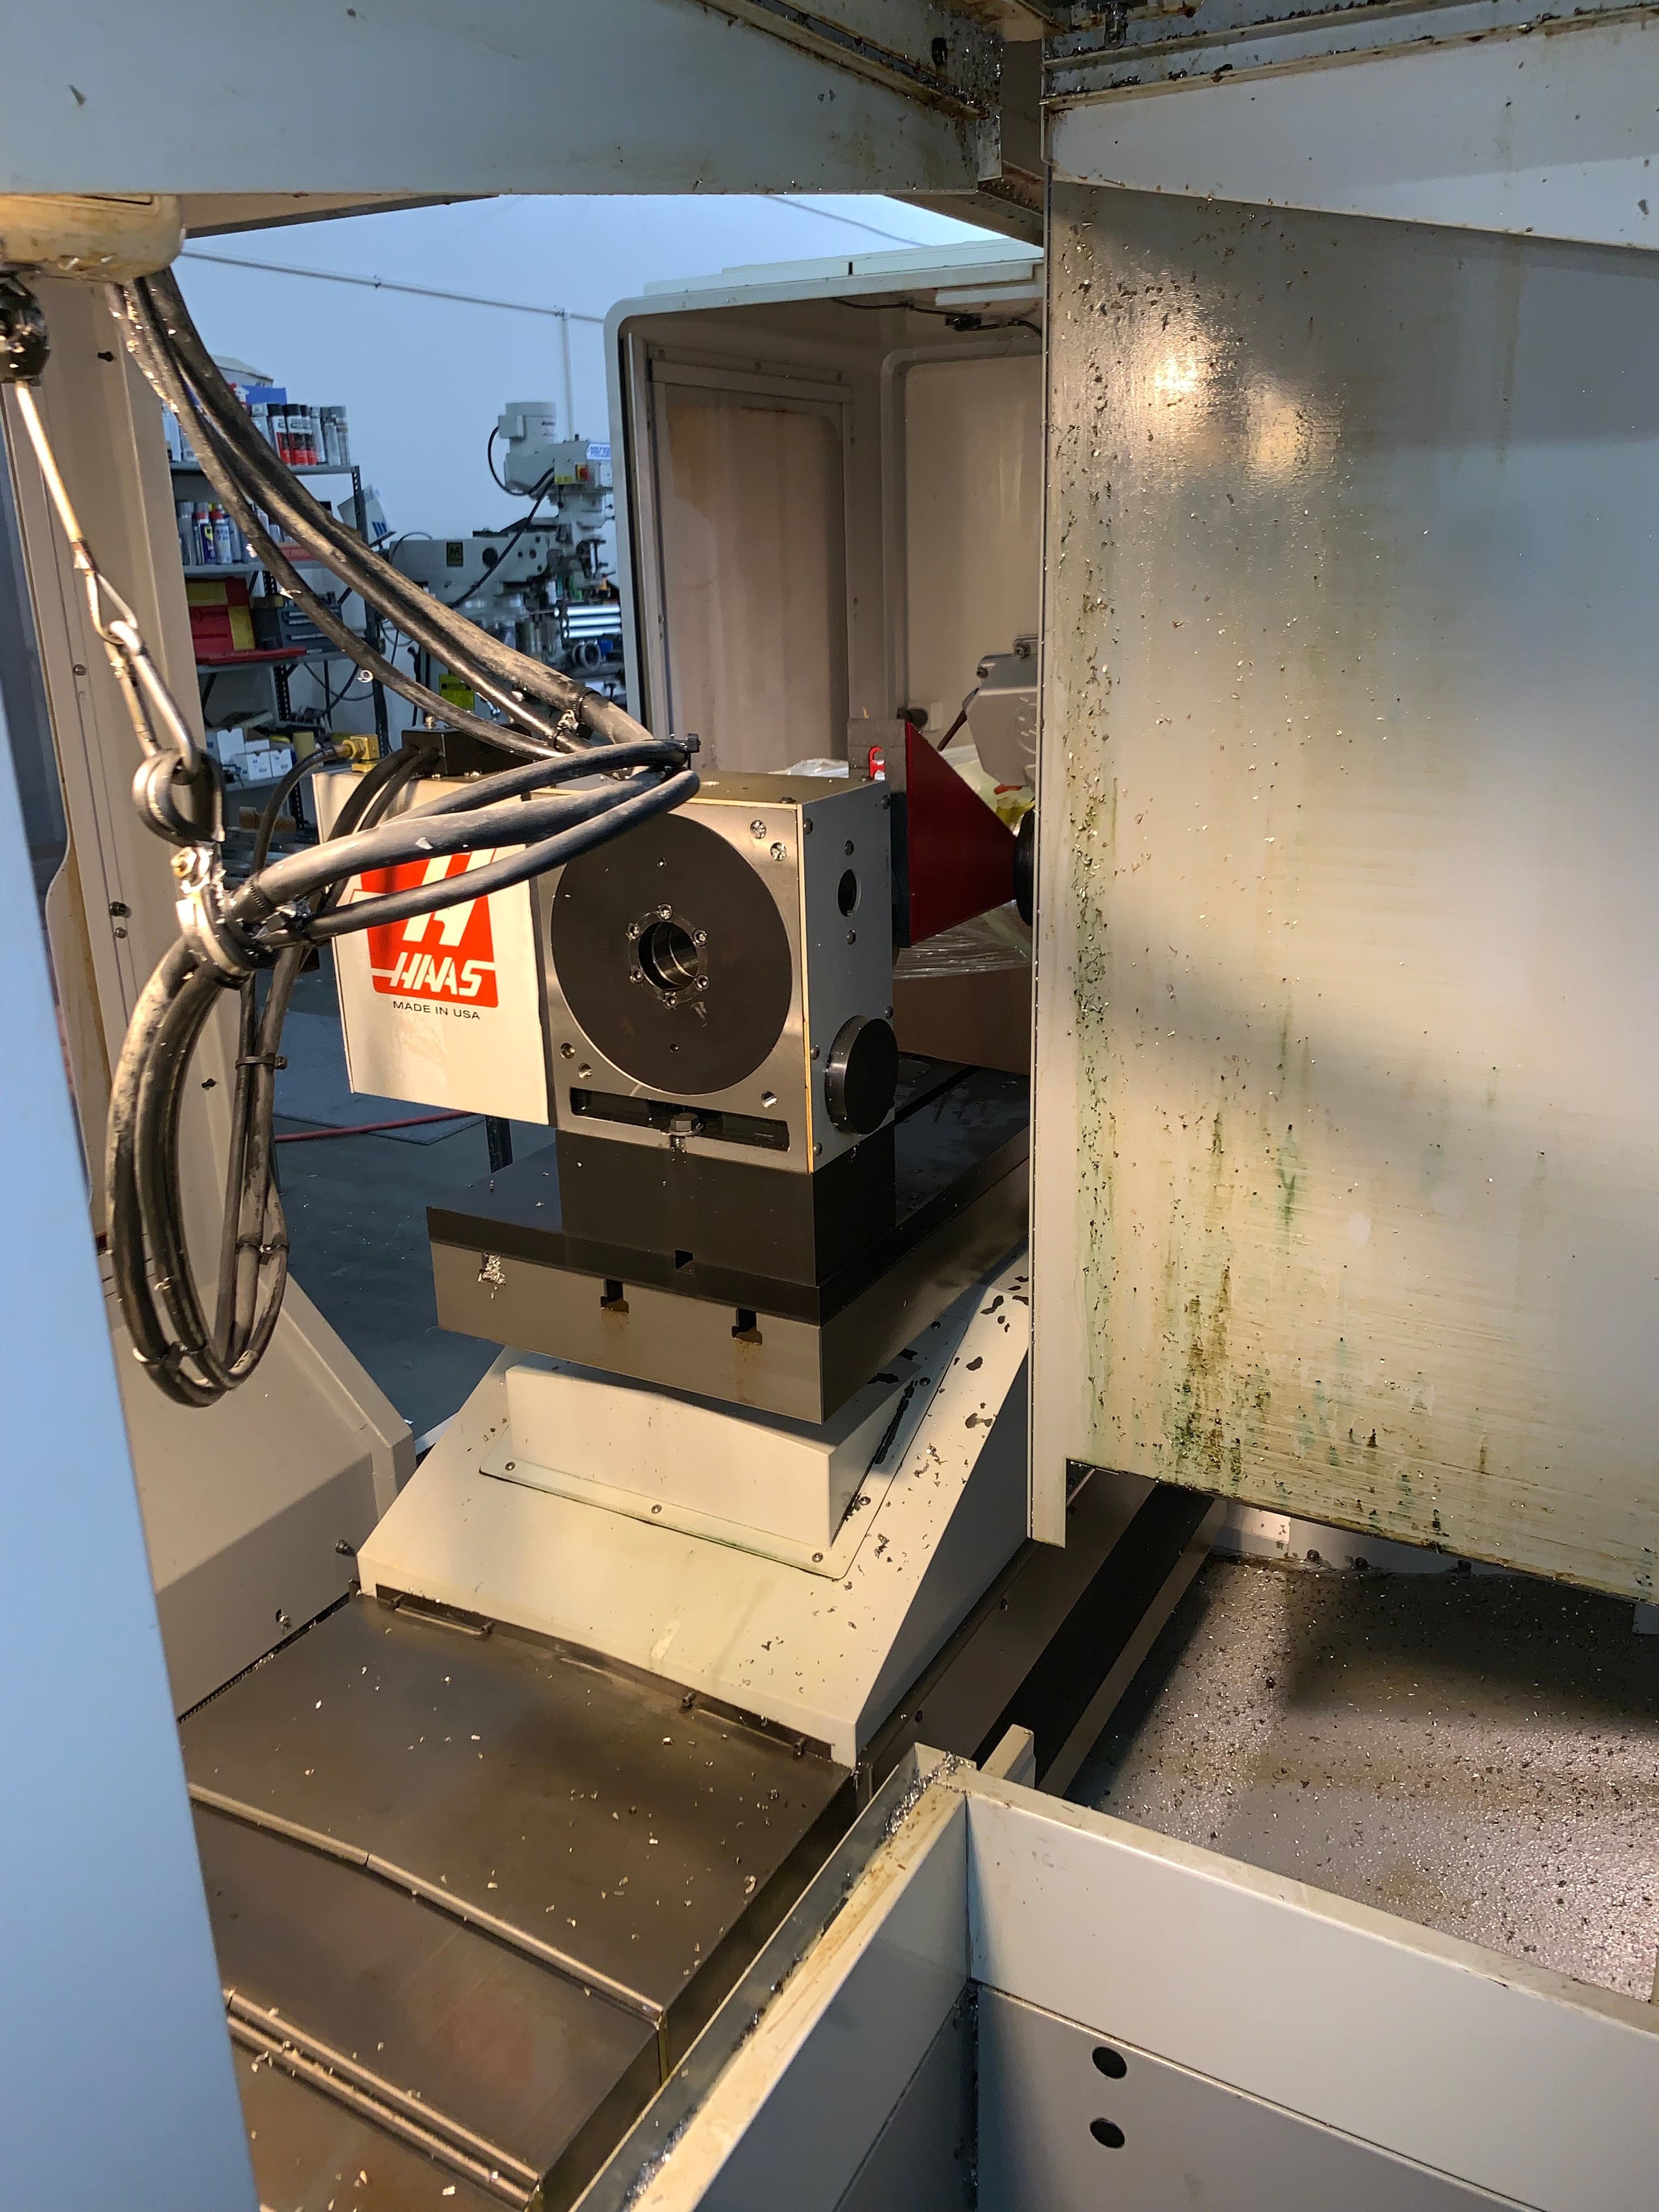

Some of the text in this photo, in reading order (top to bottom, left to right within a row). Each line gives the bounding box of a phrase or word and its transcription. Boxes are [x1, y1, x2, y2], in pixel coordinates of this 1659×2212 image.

[371, 951, 496, 997] HAAS
[393, 1000, 481, 1020] MADE IN USA
